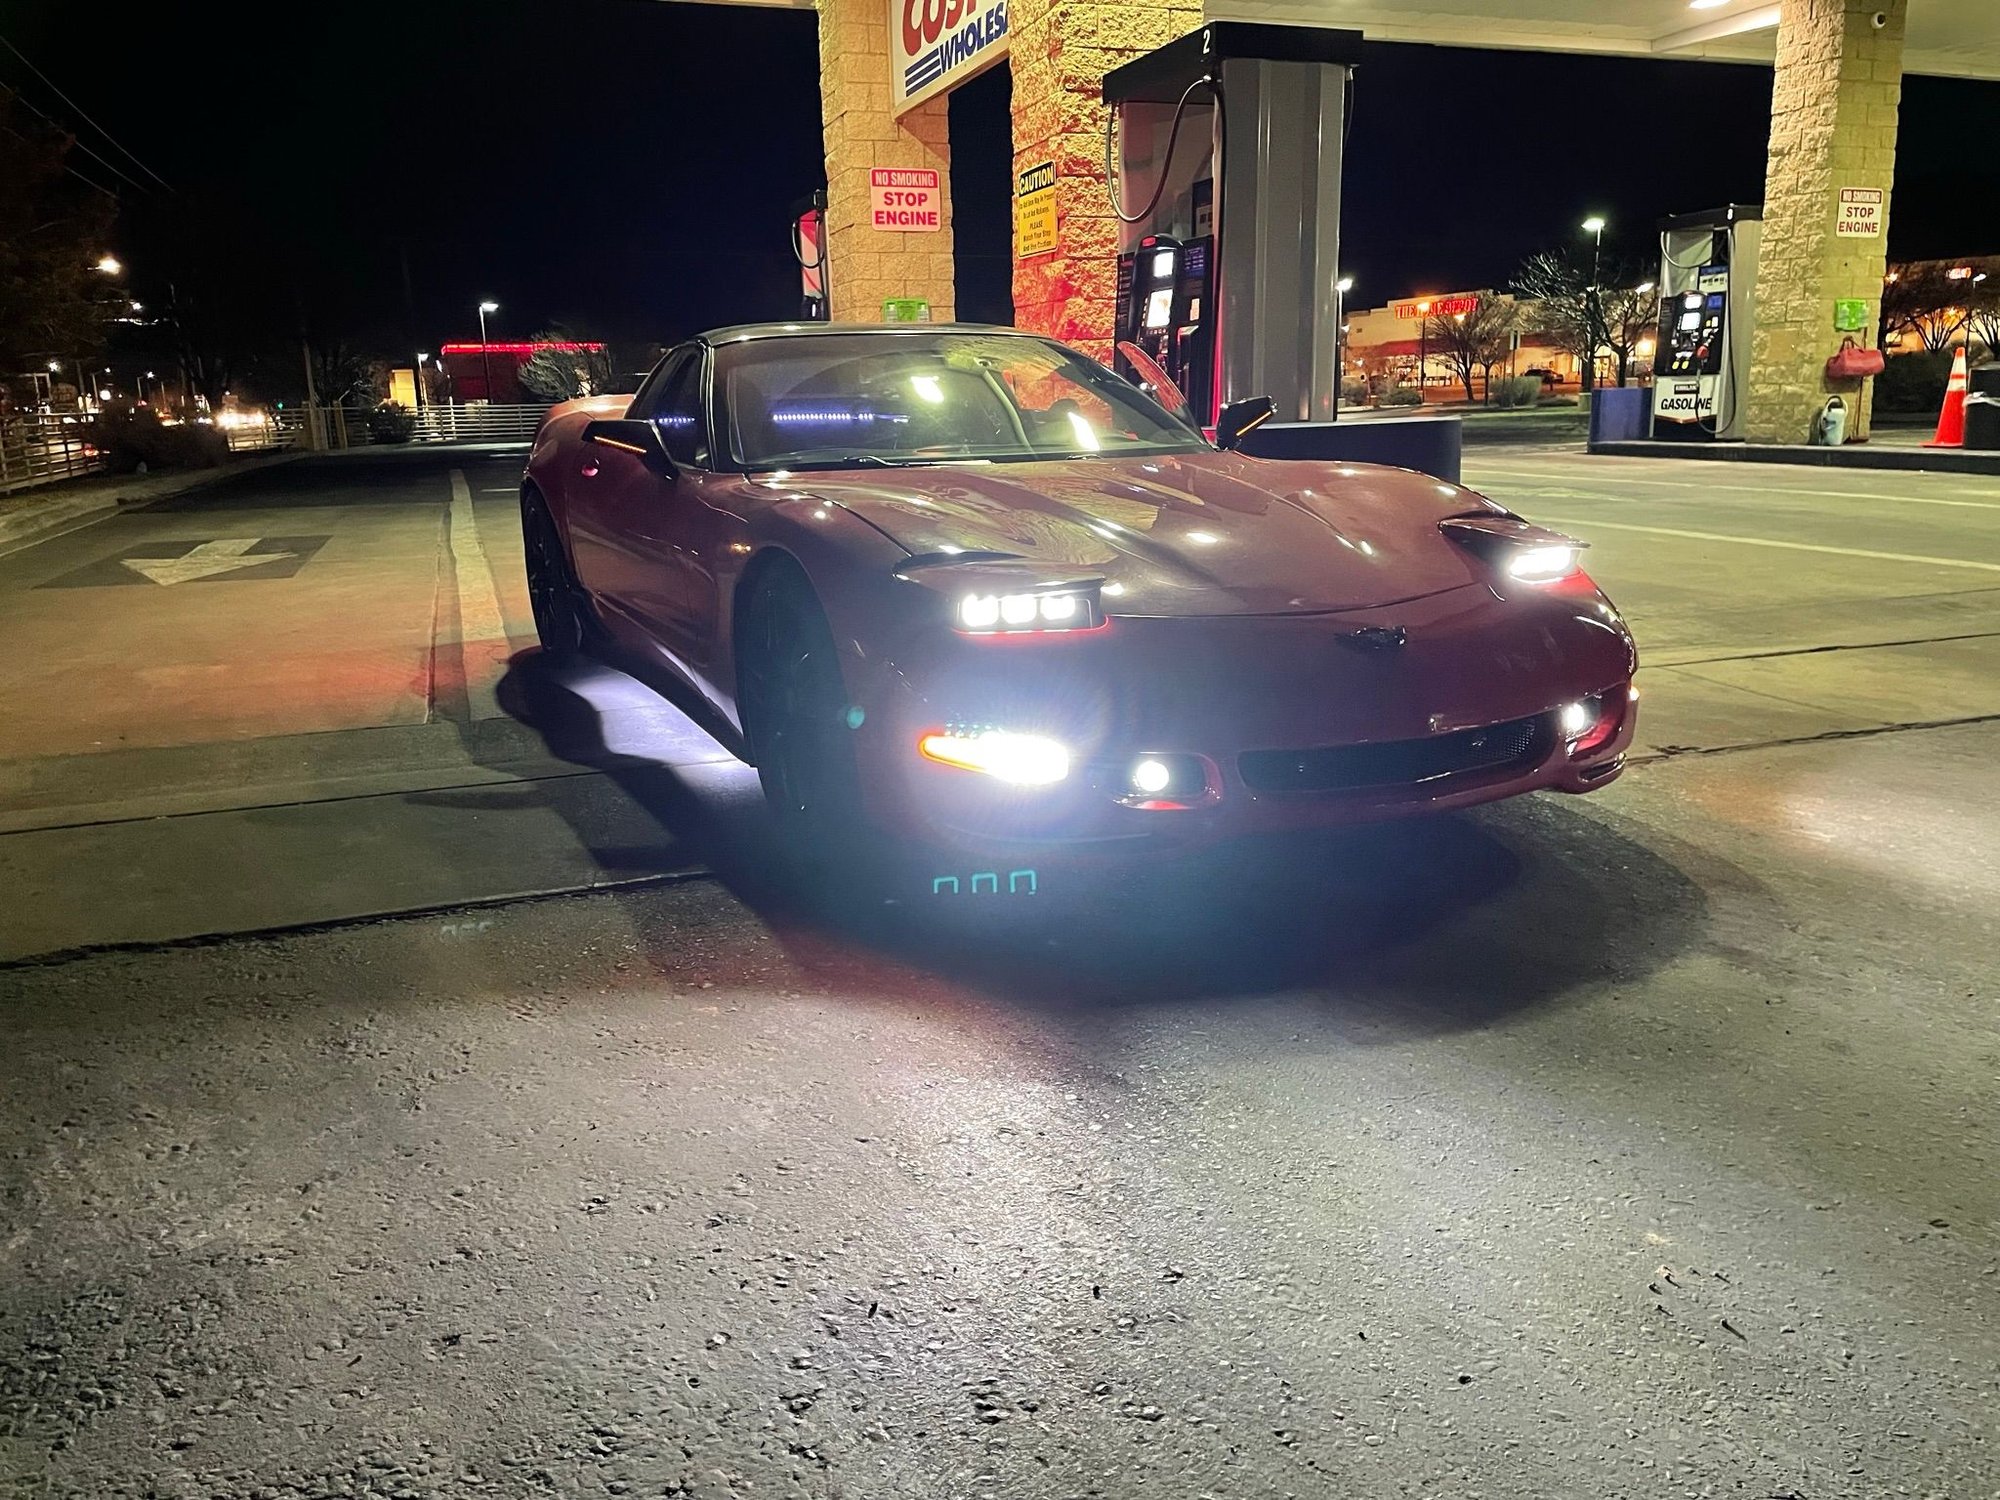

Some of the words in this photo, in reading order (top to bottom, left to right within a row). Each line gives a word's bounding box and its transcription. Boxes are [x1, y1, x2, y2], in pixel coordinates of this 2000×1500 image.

[902, 0, 976, 56] COS
[940, 2, 1008, 74] WHOLES
[1203, 29, 1211, 54] 2
[875, 171, 889, 186] NO
[890, 172, 935, 187] SMOKING
[1020, 165, 1054, 195] CAUTION
[883, 191, 928, 207] STOP
[875, 210, 938, 226] ENGINE
[1846, 206, 1875, 218] STOP
[1838, 221, 1879, 233] ENGINE
[1396, 305, 1415, 318] THE
[1416, 303, 1444, 316] HME
